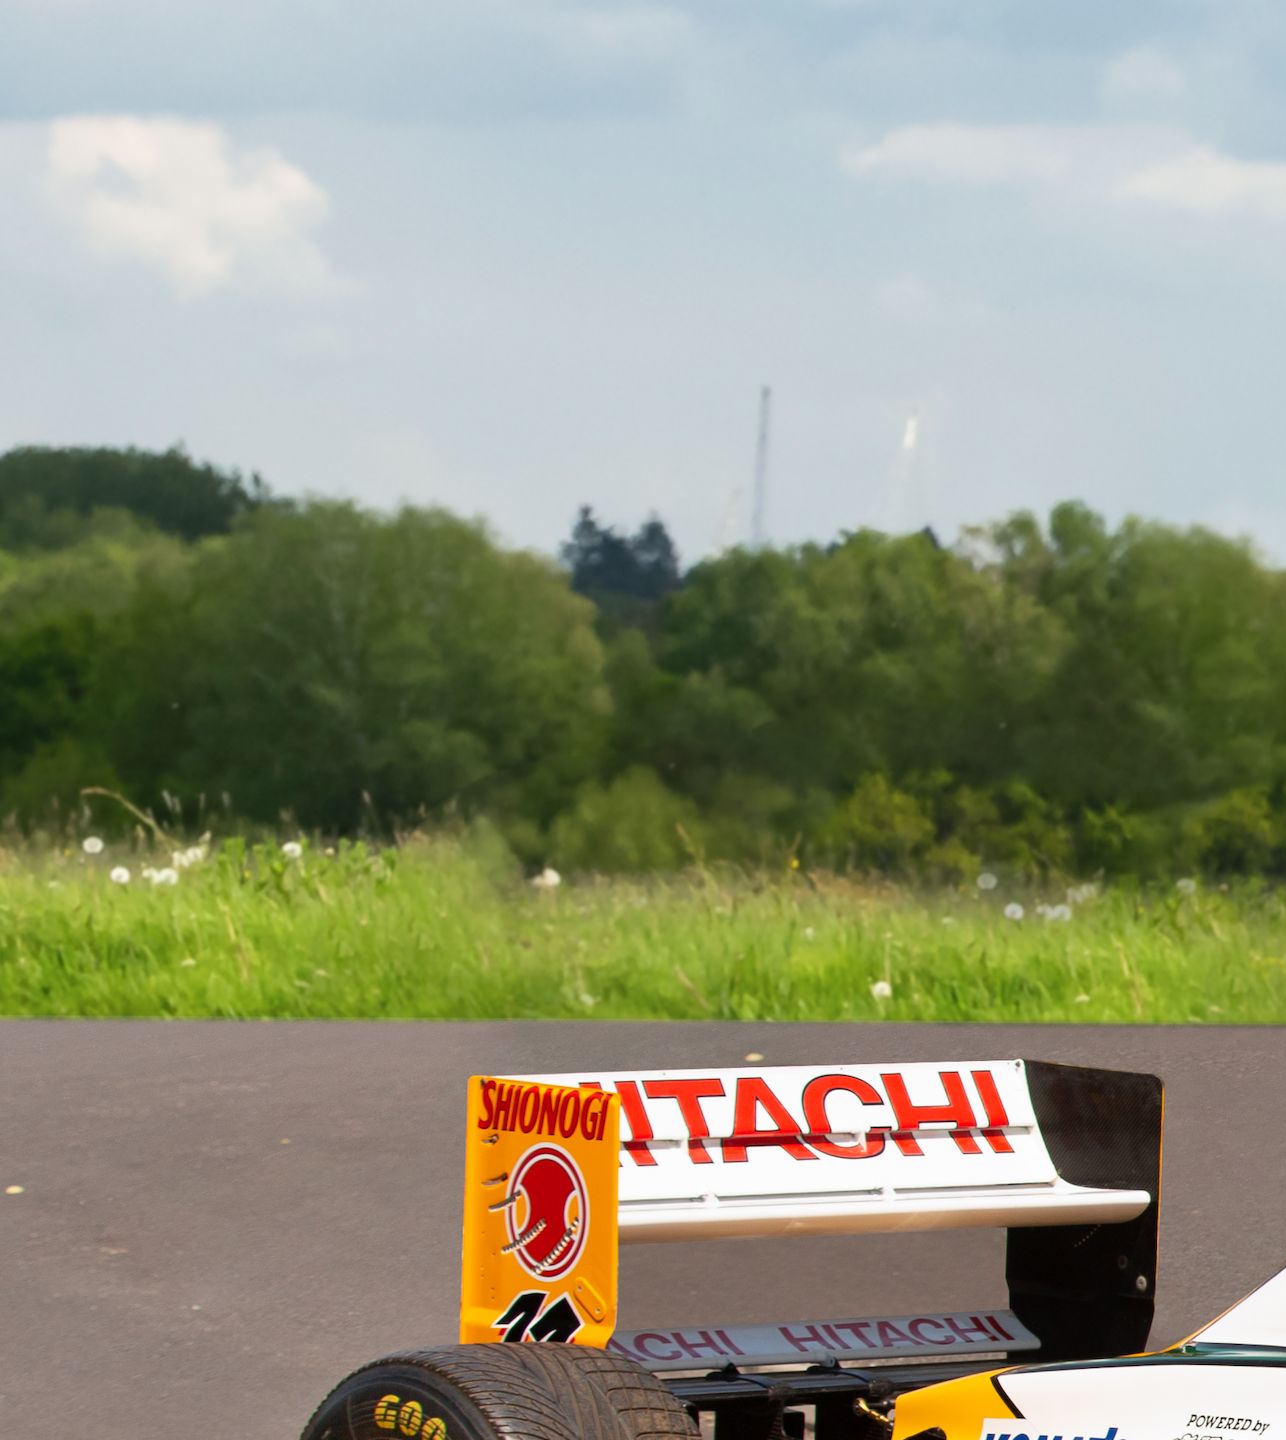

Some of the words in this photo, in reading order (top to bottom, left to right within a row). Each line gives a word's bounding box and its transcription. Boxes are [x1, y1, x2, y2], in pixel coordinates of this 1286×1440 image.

[478, 1081, 611, 1141] SHIONOGI
[579, 1069, 1016, 1167] ITACHI
[778, 1315, 1016, 1353] HITACHI
[1187, 1414, 1252, 1431] POWERED
[1252, 1420, 1270, 1436] by
